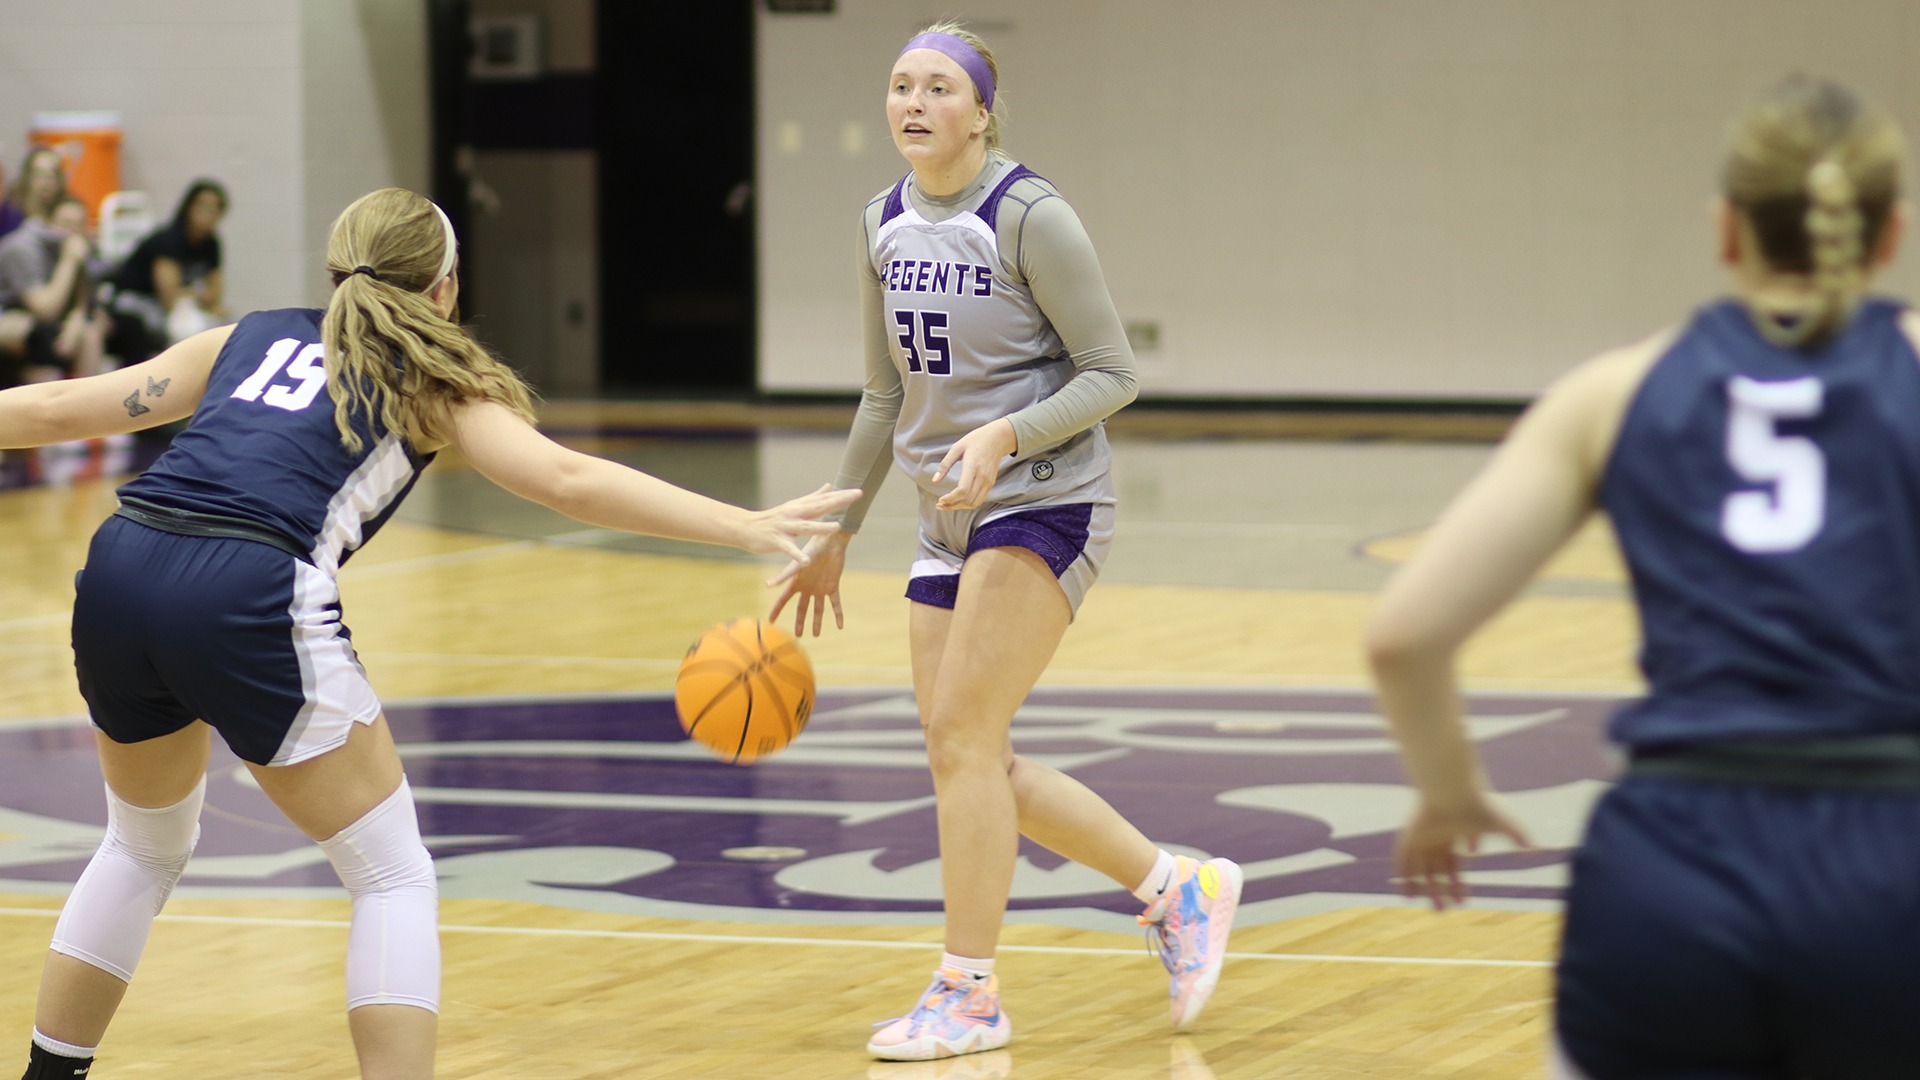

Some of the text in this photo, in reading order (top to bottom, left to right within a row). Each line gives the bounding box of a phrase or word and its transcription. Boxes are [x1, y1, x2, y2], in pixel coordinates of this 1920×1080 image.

[229, 337, 328, 412] 15
[893, 308, 953, 377] 35
[1722, 374, 1828, 555] 5
